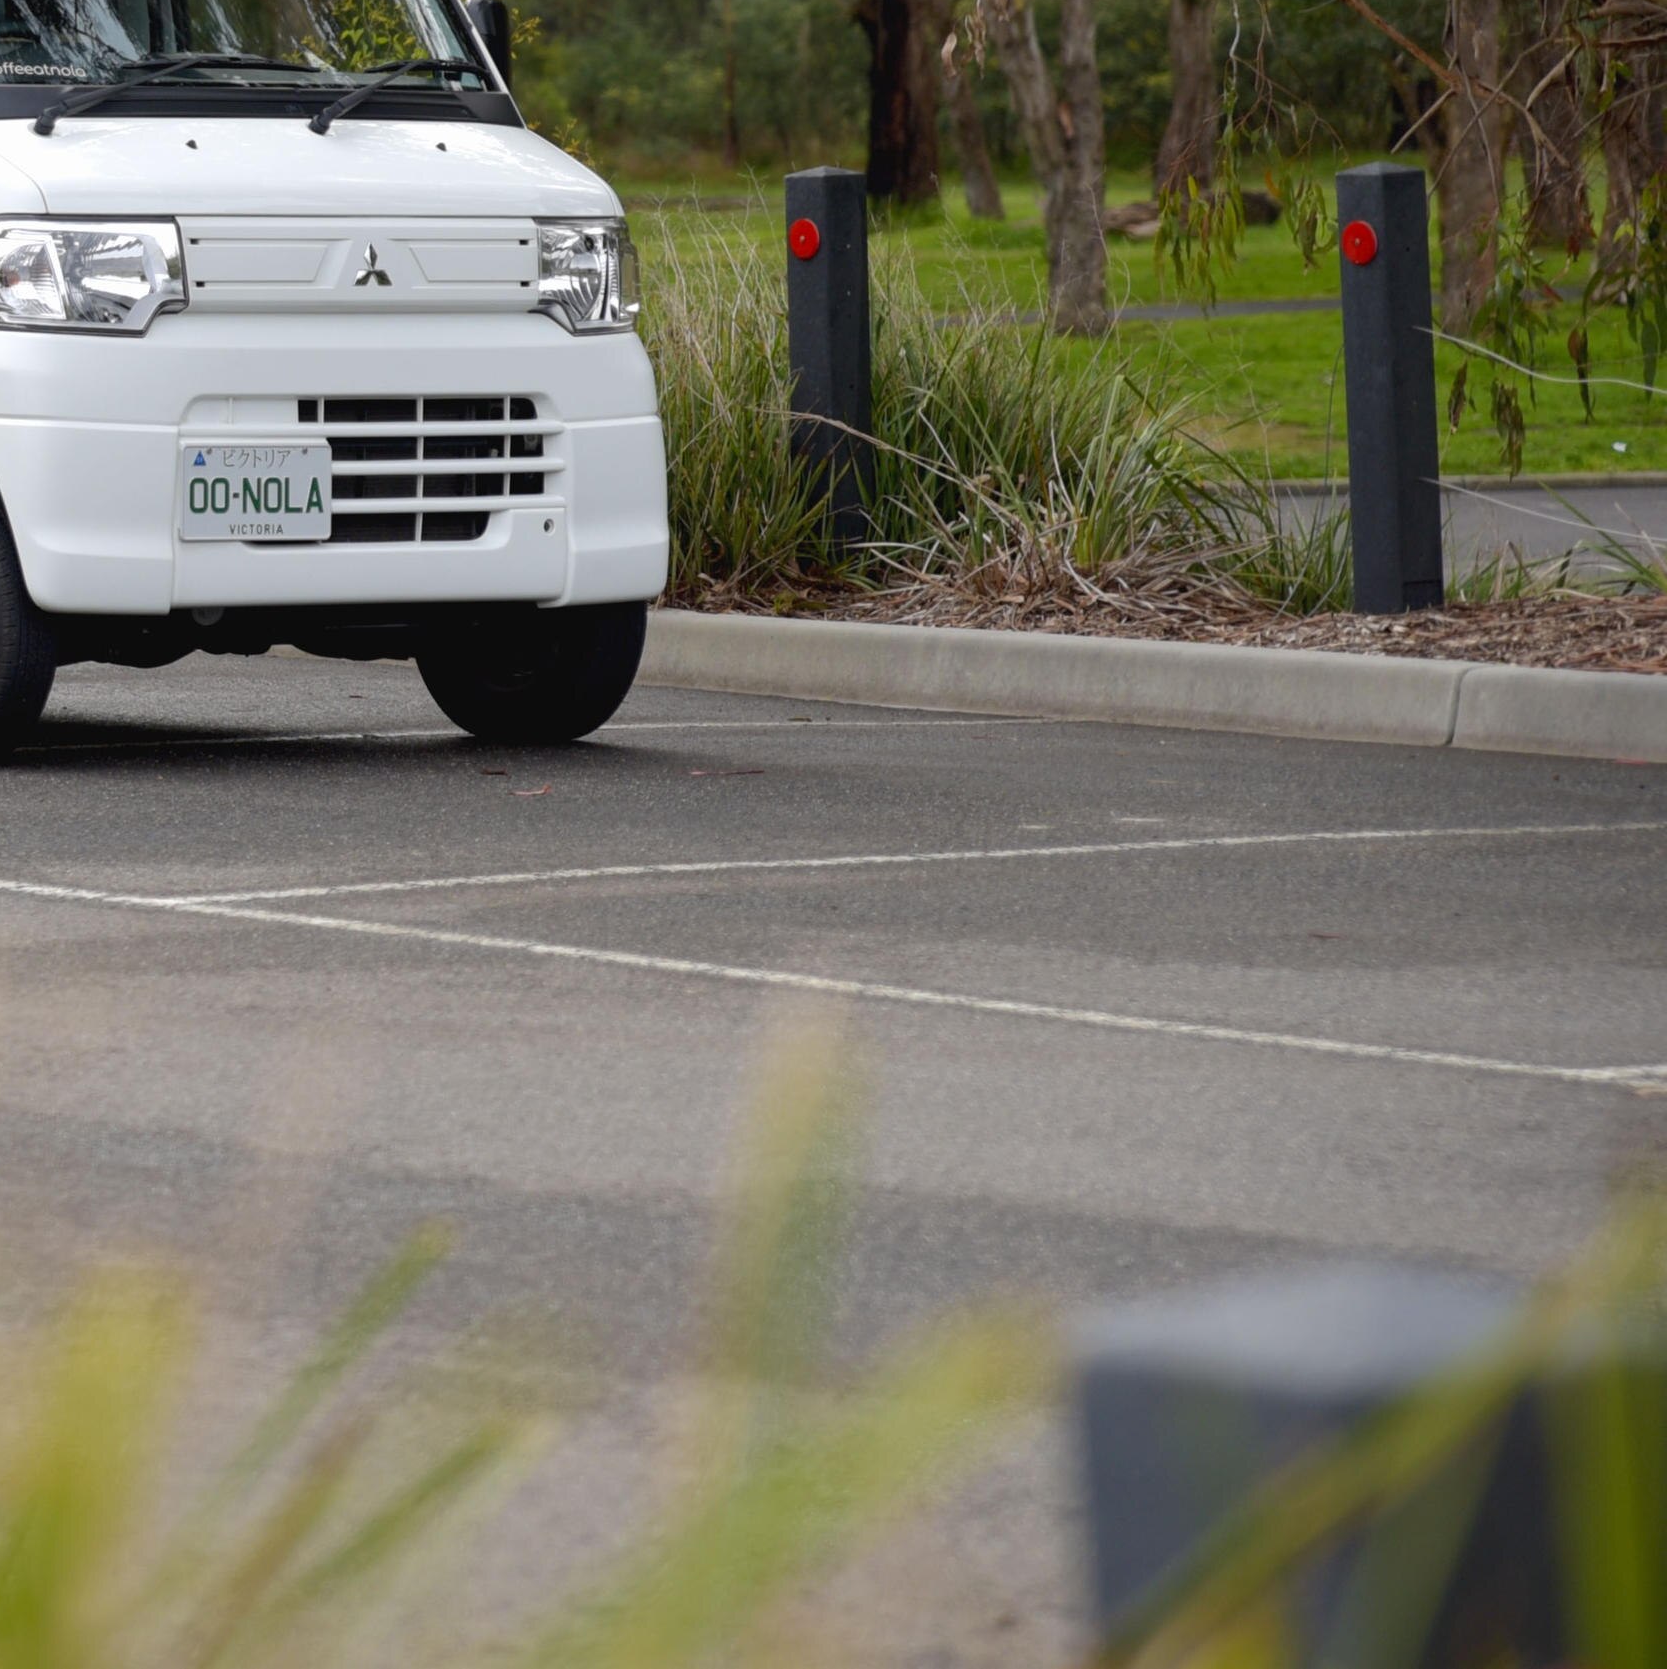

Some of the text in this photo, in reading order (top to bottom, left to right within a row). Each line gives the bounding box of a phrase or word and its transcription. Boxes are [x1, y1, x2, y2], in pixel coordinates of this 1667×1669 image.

[222, 449, 291, 468] ビクトリア
[229, 524, 284, 535] VICTORIA
